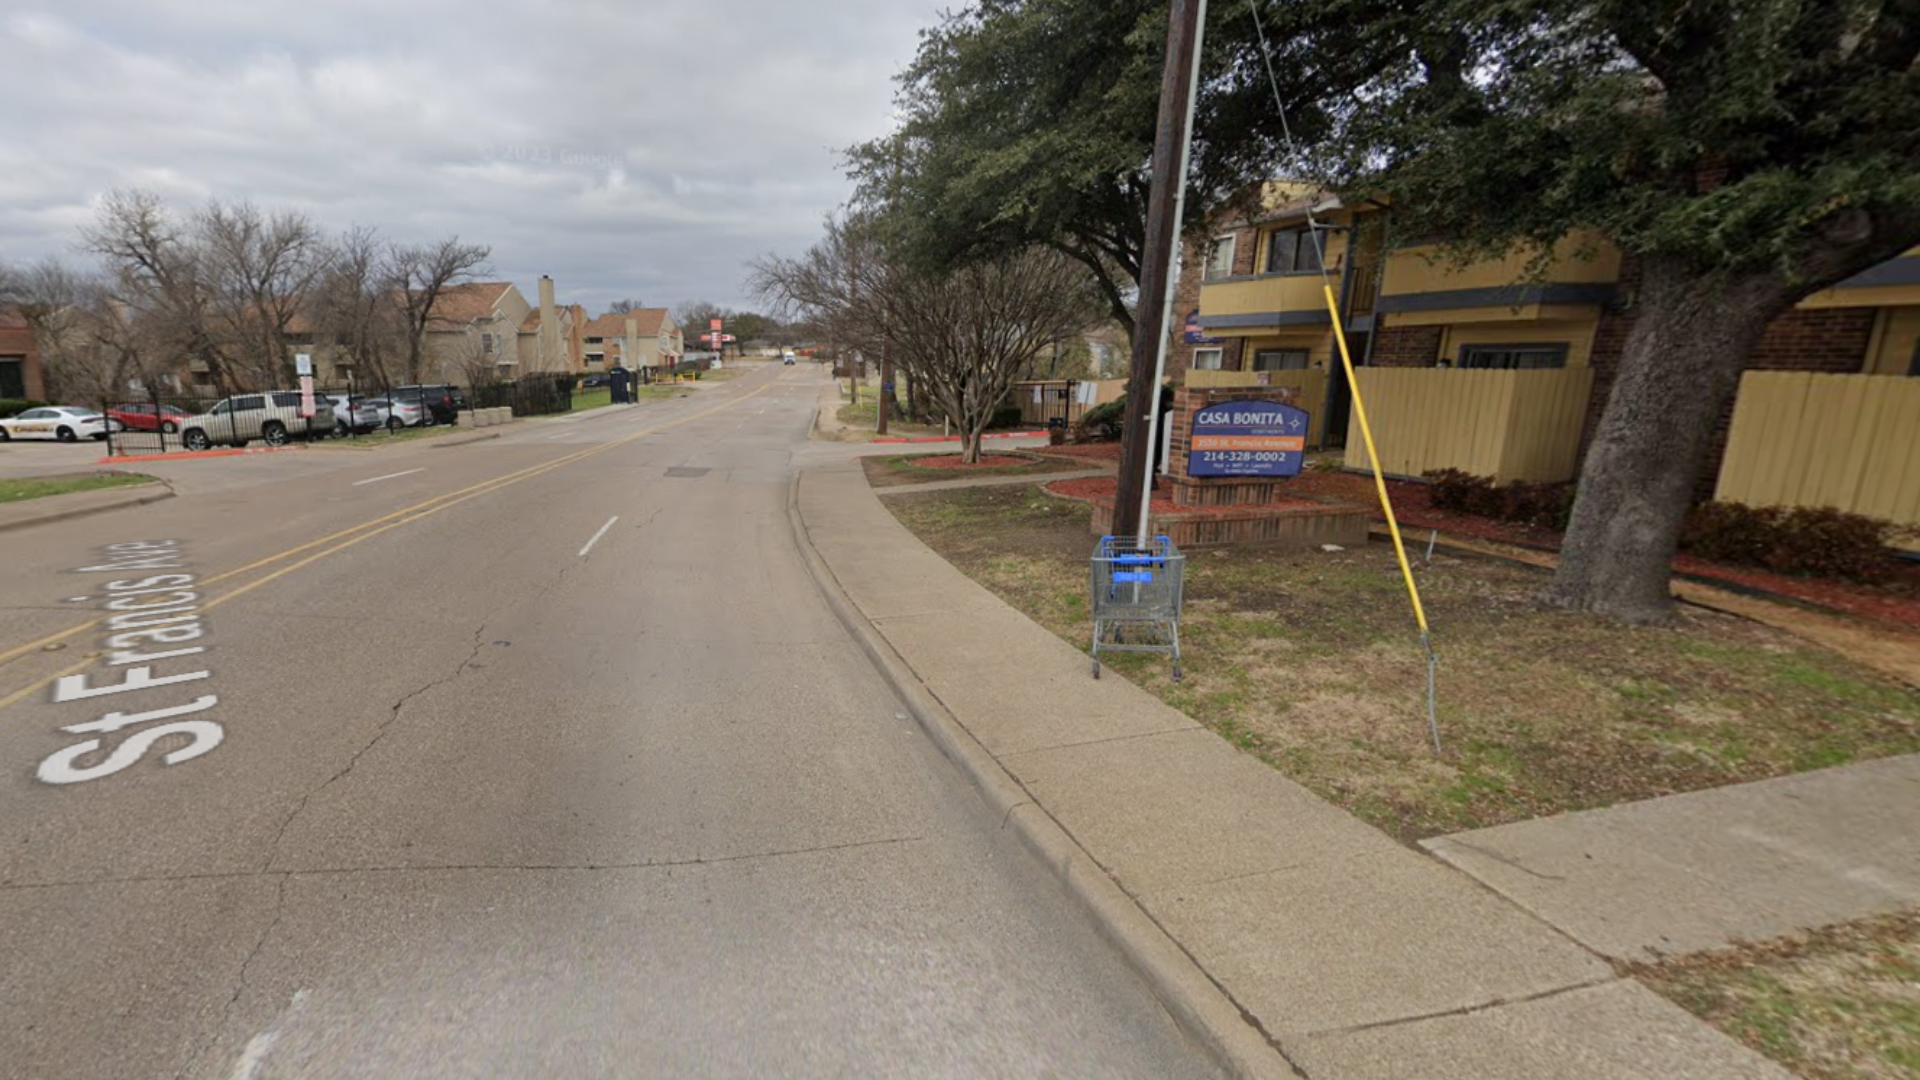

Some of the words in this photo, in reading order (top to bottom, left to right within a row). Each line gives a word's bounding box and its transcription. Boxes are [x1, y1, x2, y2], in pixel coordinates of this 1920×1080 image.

[1198, 412, 1230, 425] CASA
[1233, 412, 1284, 425] BONITA
[1203, 451, 1286, 462] 214-328-0002
